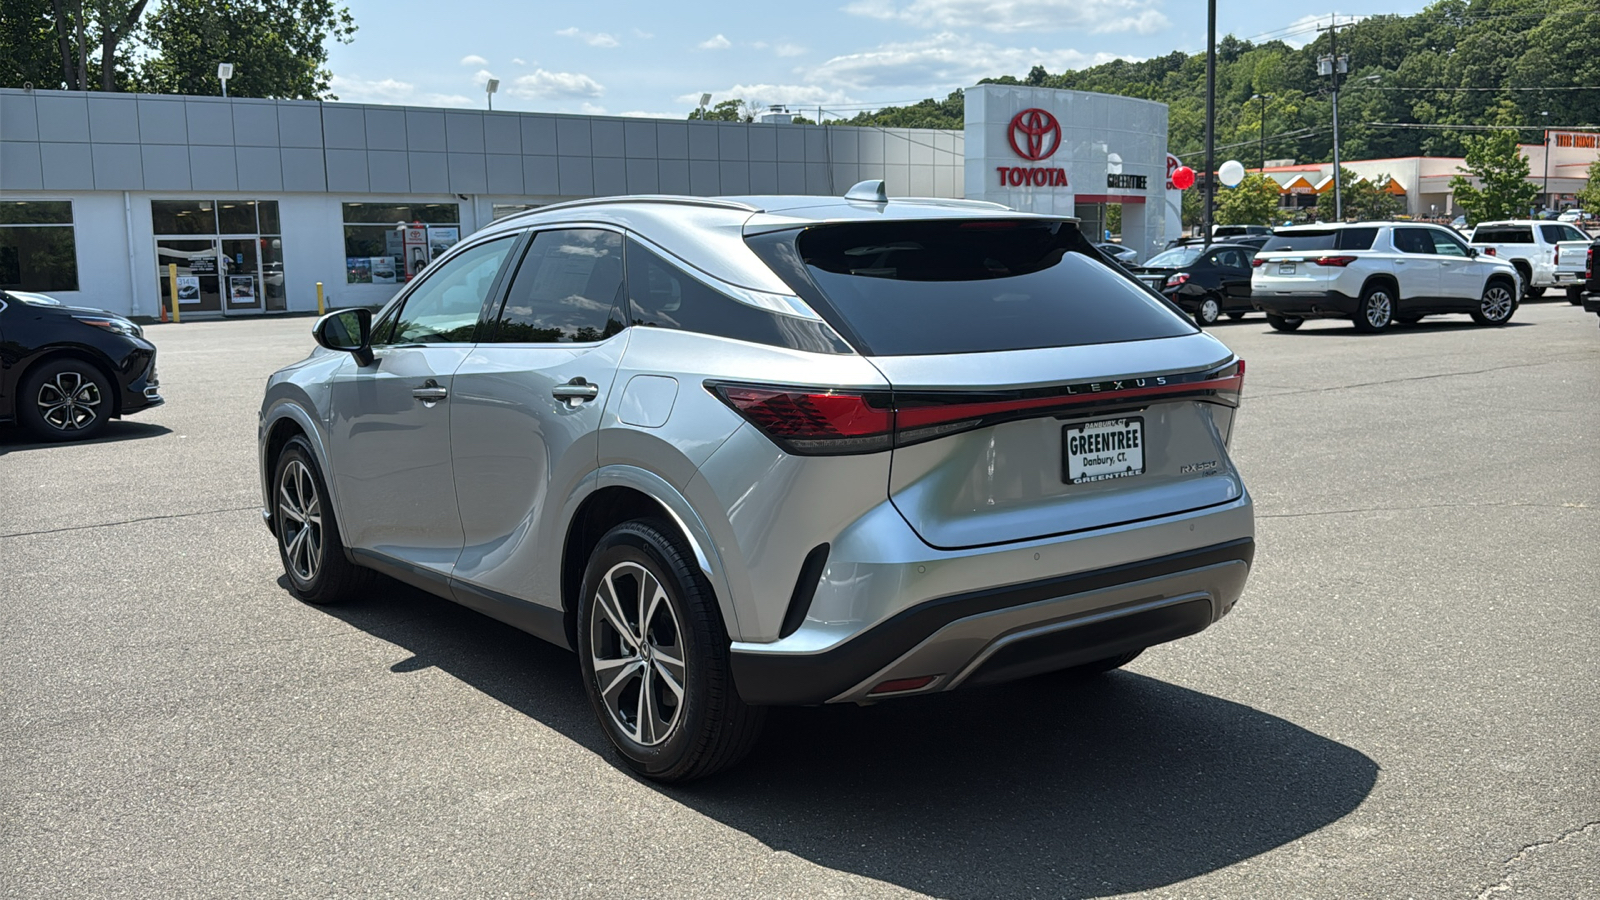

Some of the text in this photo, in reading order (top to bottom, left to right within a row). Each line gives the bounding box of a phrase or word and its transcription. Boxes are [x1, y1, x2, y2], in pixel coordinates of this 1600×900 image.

[997, 166, 1068, 187] TOYOTA
[1067, 377, 1166, 394] LEXUS
[1070, 429, 1139, 456] GREENTREE
[1083, 452, 1127, 467] Danbury, CT.
[1073, 469, 1142, 484] GREENTREE
